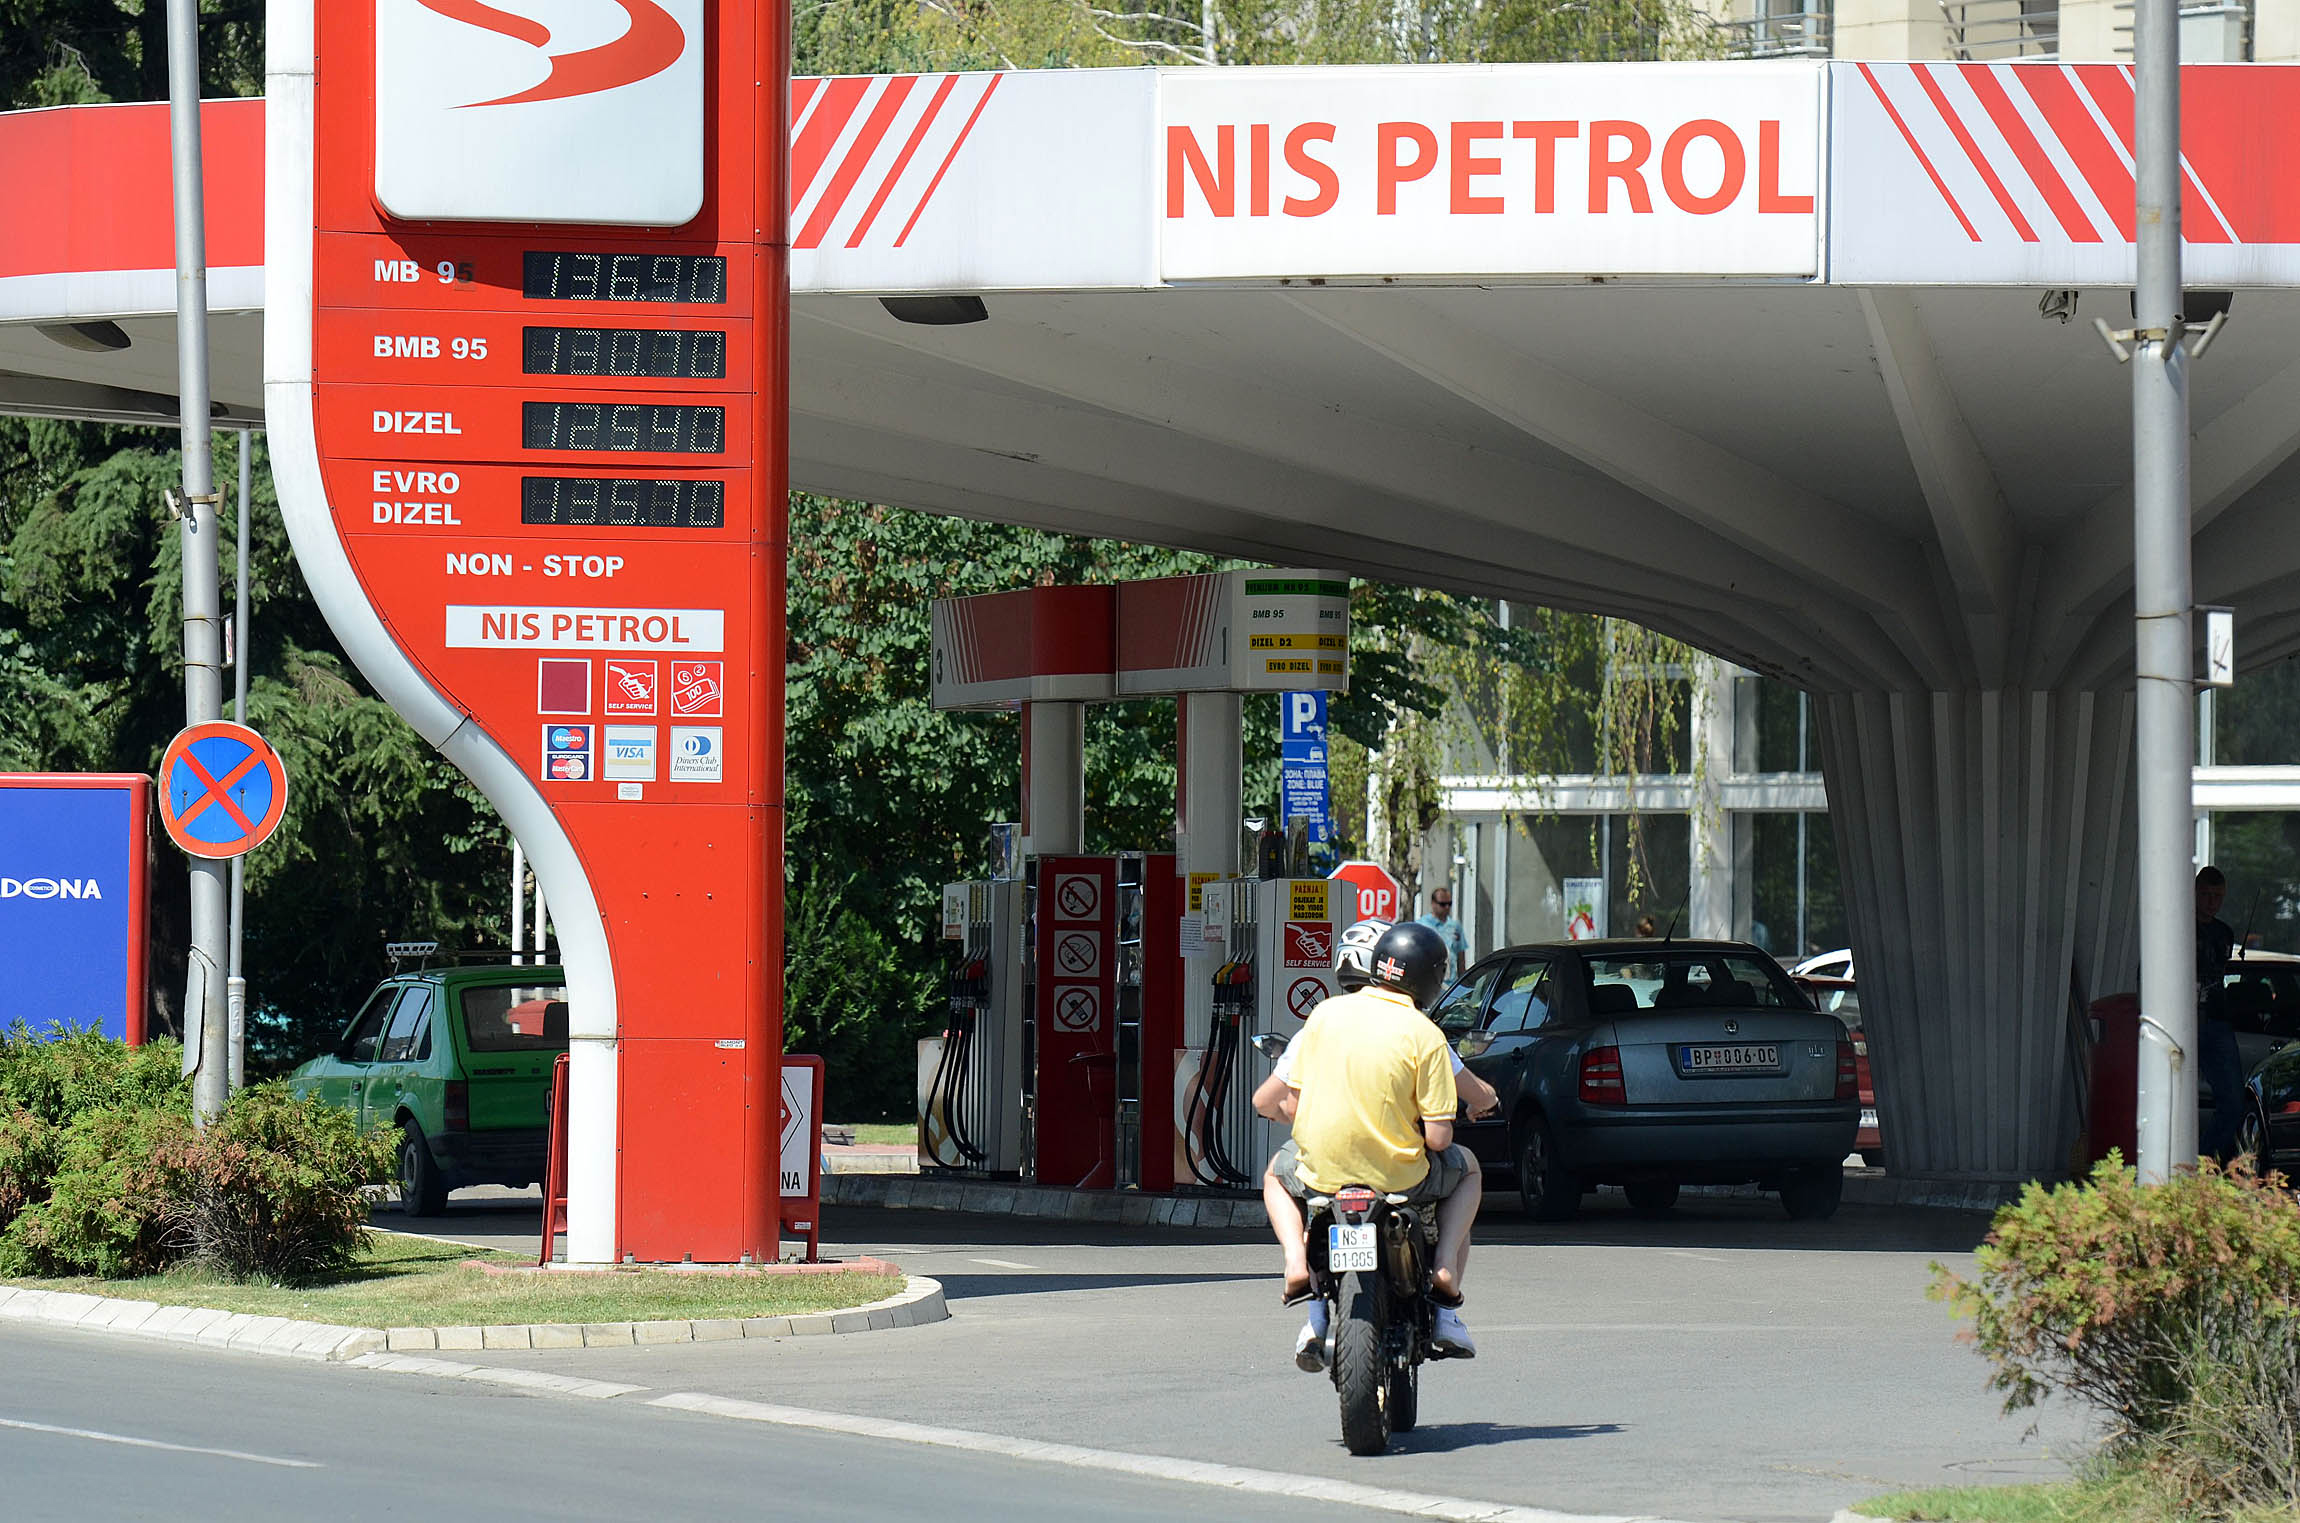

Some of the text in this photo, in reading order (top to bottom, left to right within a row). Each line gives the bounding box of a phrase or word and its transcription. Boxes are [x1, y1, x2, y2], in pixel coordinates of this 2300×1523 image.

[1166, 118, 1815, 218] NIS PETROL
[374, 260, 419, 283] MB
[373, 336, 488, 360] BMB 95
[373, 411, 462, 435] DIZEL
[373, 471, 460, 494] EVRO
[373, 502, 462, 526] DIZEL
[446, 553, 513, 576] NON
[543, 555, 624, 577] STOP
[1252, 610, 1285, 619] BMB 95
[481, 612, 690, 643] NIS PETROL
[1251, 638, 1292, 647] DIZEL D2
[682, 672, 690, 682] 5
[936, 648, 943, 685] 3
[1290, 662, 1310, 671] DIZEL
[686, 685, 702, 701] 100
[1292, 693, 1317, 733] P
[555, 735, 582, 743] Maestro
[616, 747, 644, 759] VISA
[676, 756, 718, 765] Diners Club
[674, 763, 719, 773] International
[0, 878, 102, 899] DONA
[1357, 889, 1391, 916] OP
[1694, 1050, 1712, 1065] BP
[1342, 1229, 1357, 1246] NS
